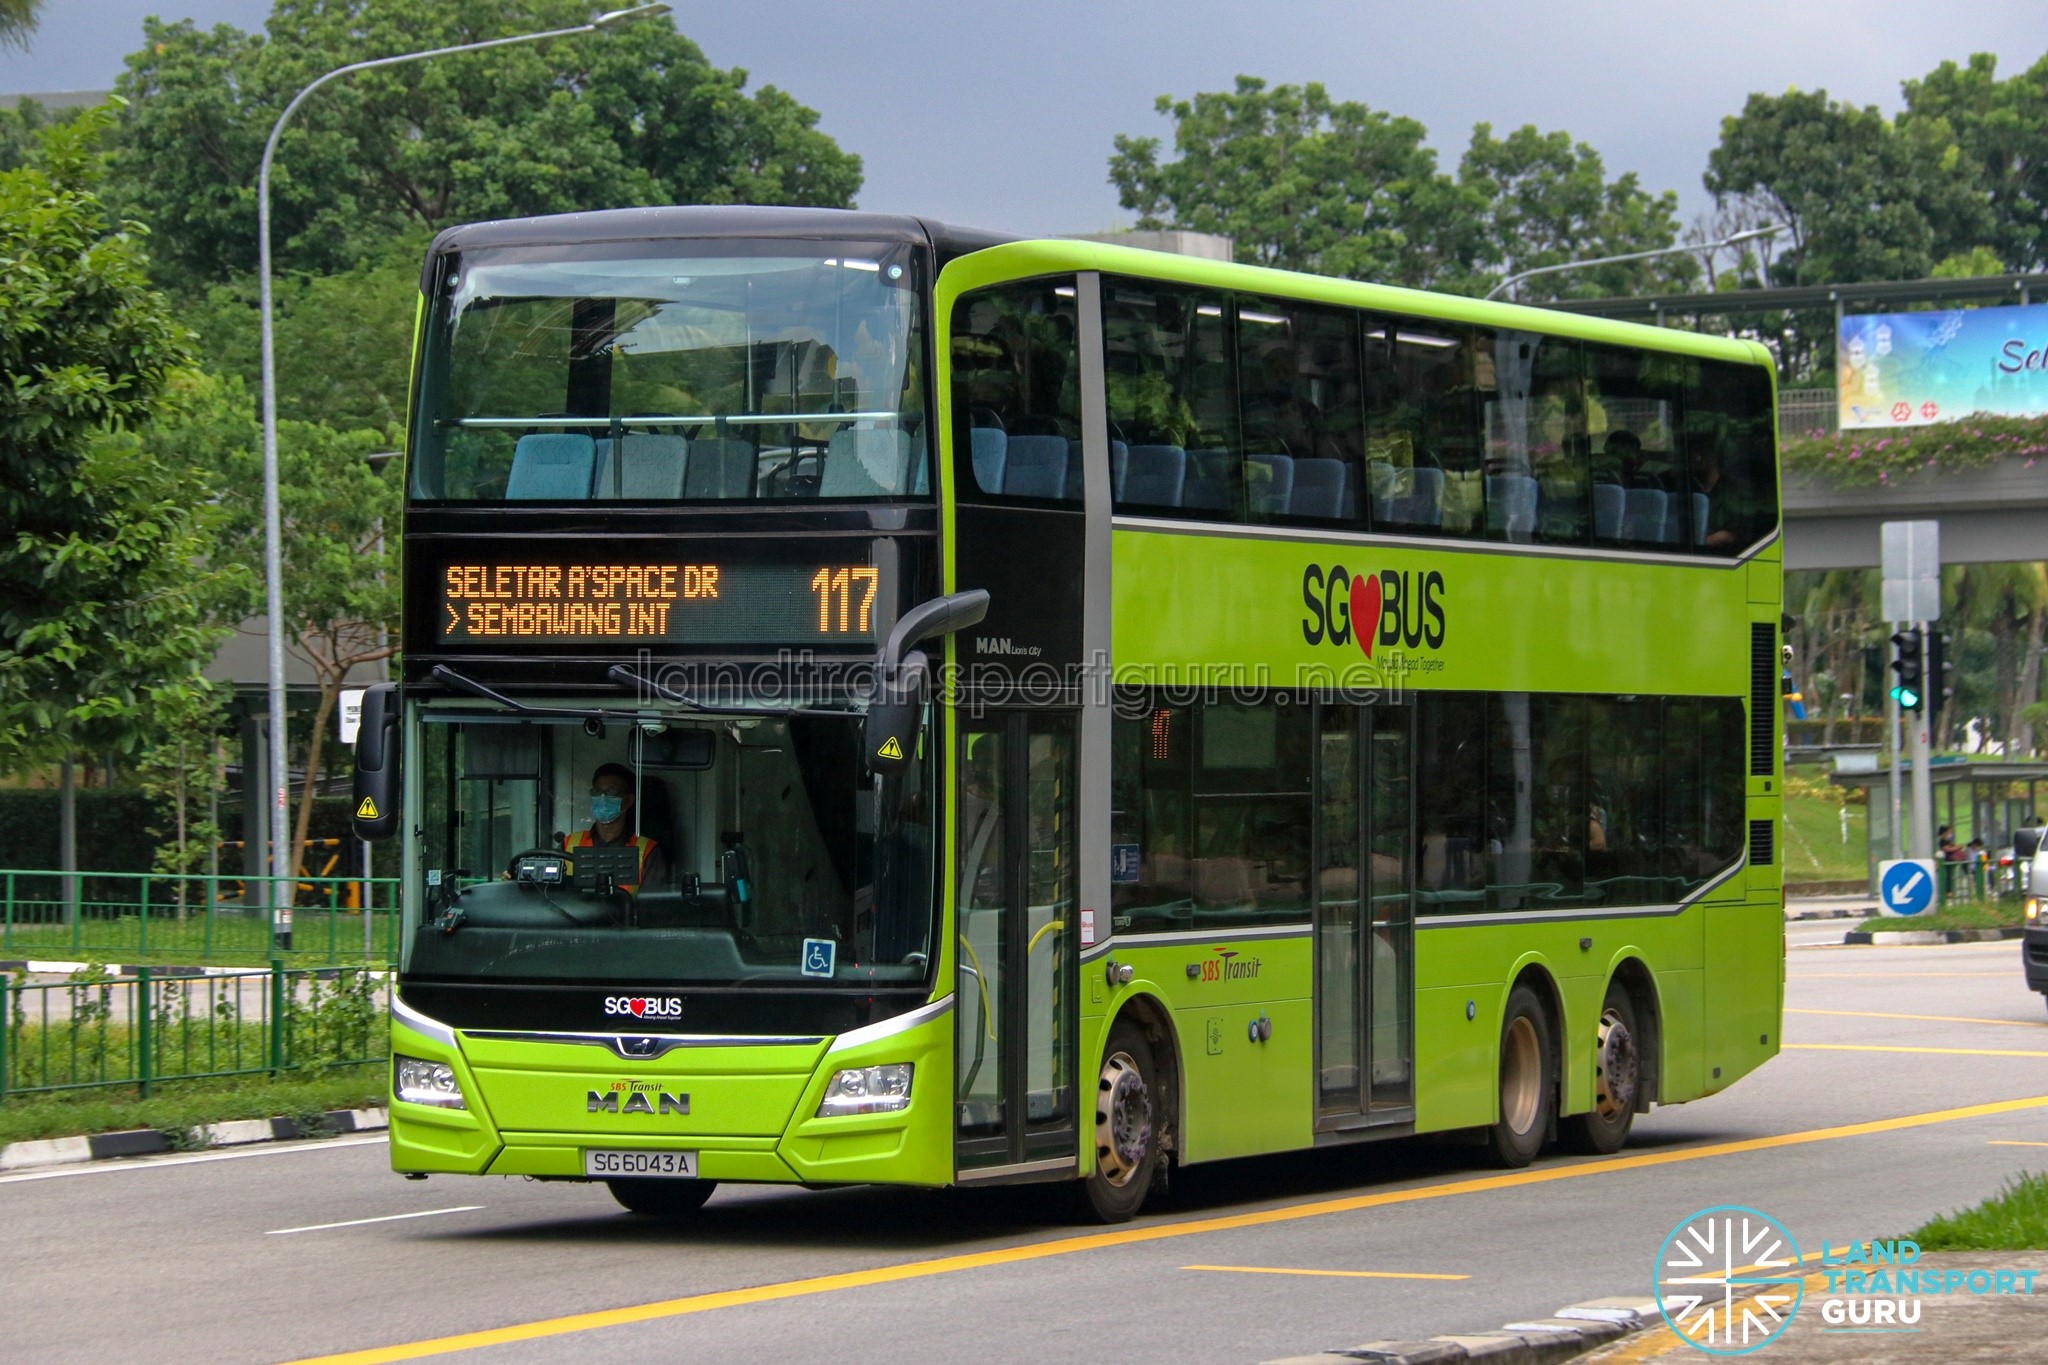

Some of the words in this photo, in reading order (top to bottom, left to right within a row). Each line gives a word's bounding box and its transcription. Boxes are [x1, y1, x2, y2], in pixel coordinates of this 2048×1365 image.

[447, 566, 562, 598] SELETAR
[568, 566, 678, 598] A'SPACE
[684, 566, 719, 598] DR
[811, 567, 878, 633] 117
[467, 603, 621, 635] SEMBAWANG
[627, 603, 671, 635] INT
[976, 637, 1011, 655] MAN
[1201, 959, 1220, 982] SBS
[1219, 951, 1262, 984] Transit
[610, 1082, 627, 1092] SBS
[627, 1080, 664, 1092] Transit
[587, 1090, 691, 1115] MAN
[594, 1153, 690, 1173] SG6043A
